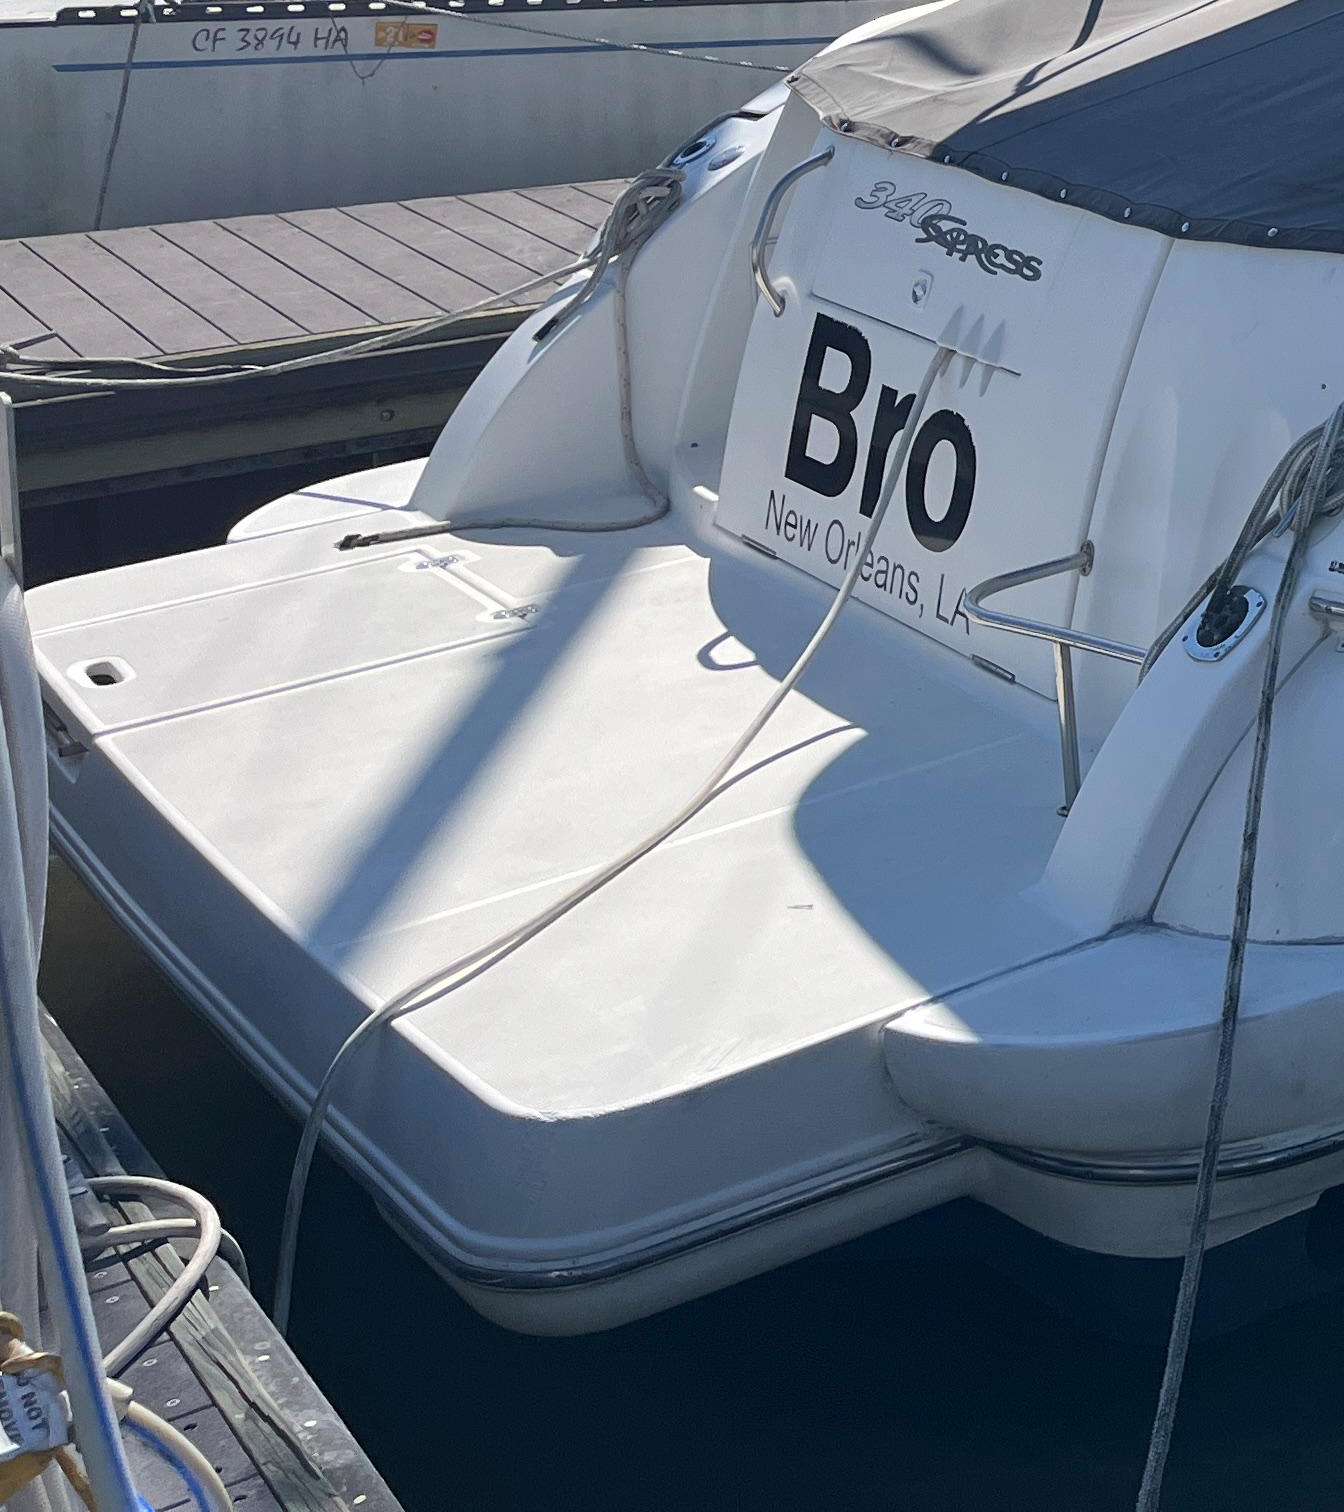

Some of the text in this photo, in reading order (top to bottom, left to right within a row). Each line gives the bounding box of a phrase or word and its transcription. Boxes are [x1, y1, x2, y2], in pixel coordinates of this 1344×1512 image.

[192, 26, 348, 52] CF 3894 HA
[855, 181, 952, 228] 340
[785, 312, 976, 552] Bro
[766, 490, 971, 635] New Orleans, LA
[21, 1391, 50, 1431] NOT
